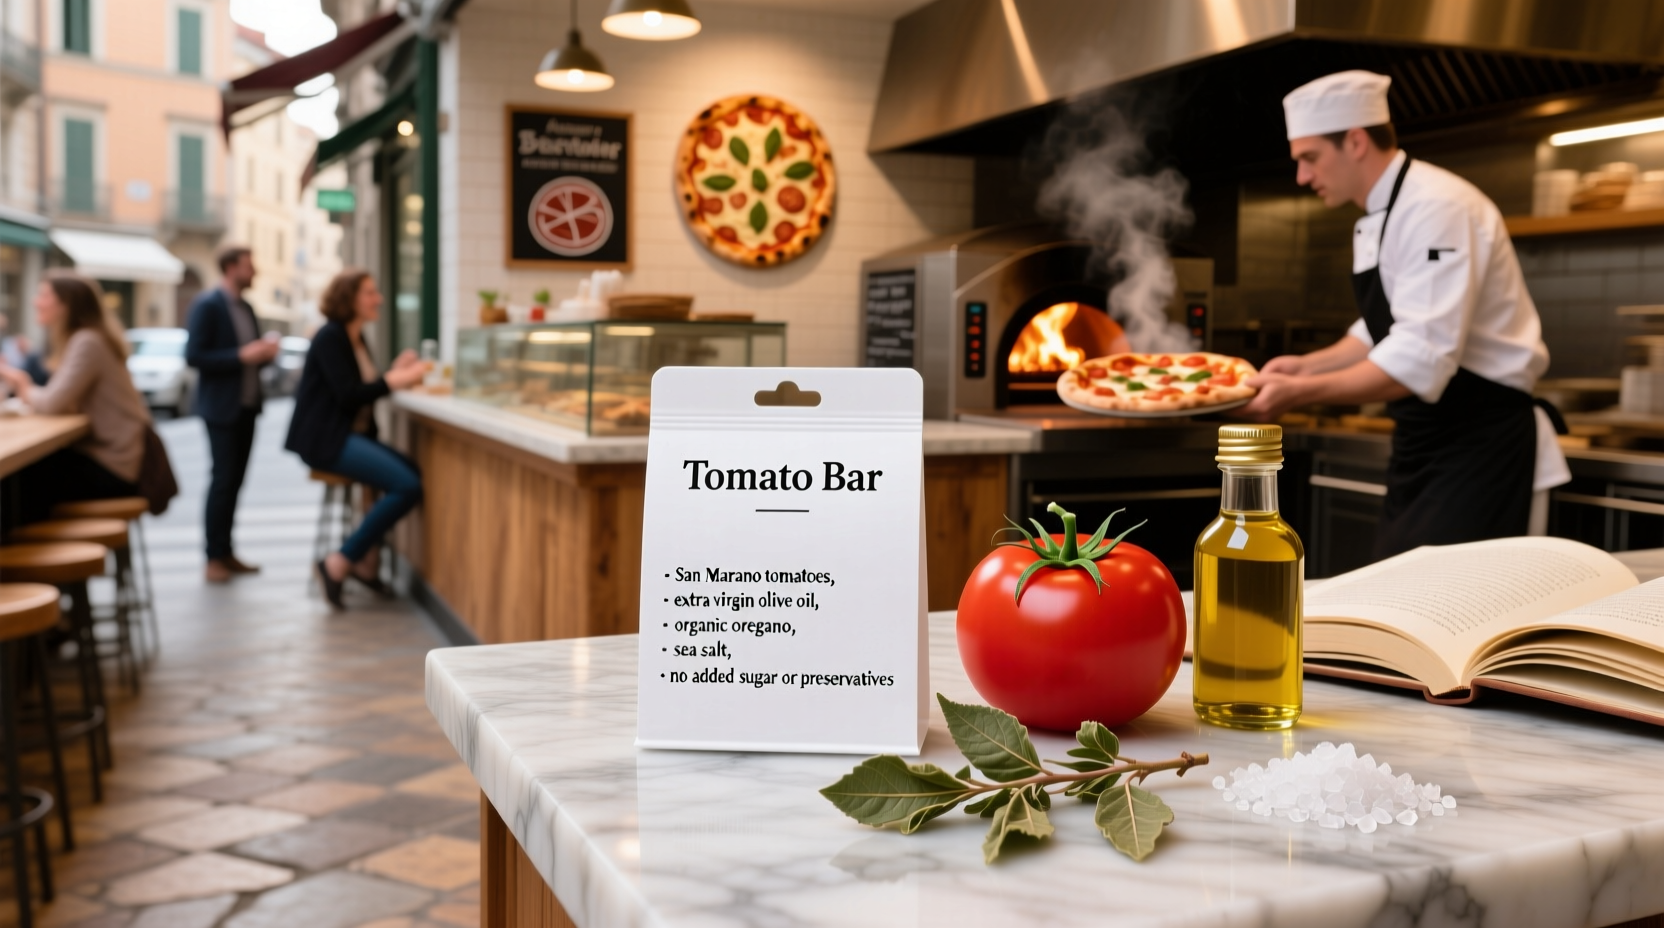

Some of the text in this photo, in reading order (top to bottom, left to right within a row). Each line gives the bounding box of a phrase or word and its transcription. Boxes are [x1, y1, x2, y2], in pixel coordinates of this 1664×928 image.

[683, 460, 883, 491] Tomato Bar
[675, 566, 836, 587] San Marano tomatoes,
[674, 591, 819, 612] extra virgin olive oil,
[674, 617, 796, 637] organic oregano,
[673, 640, 732, 660] sea salt,
[669, 667, 895, 689] no added sugar or preservatives
